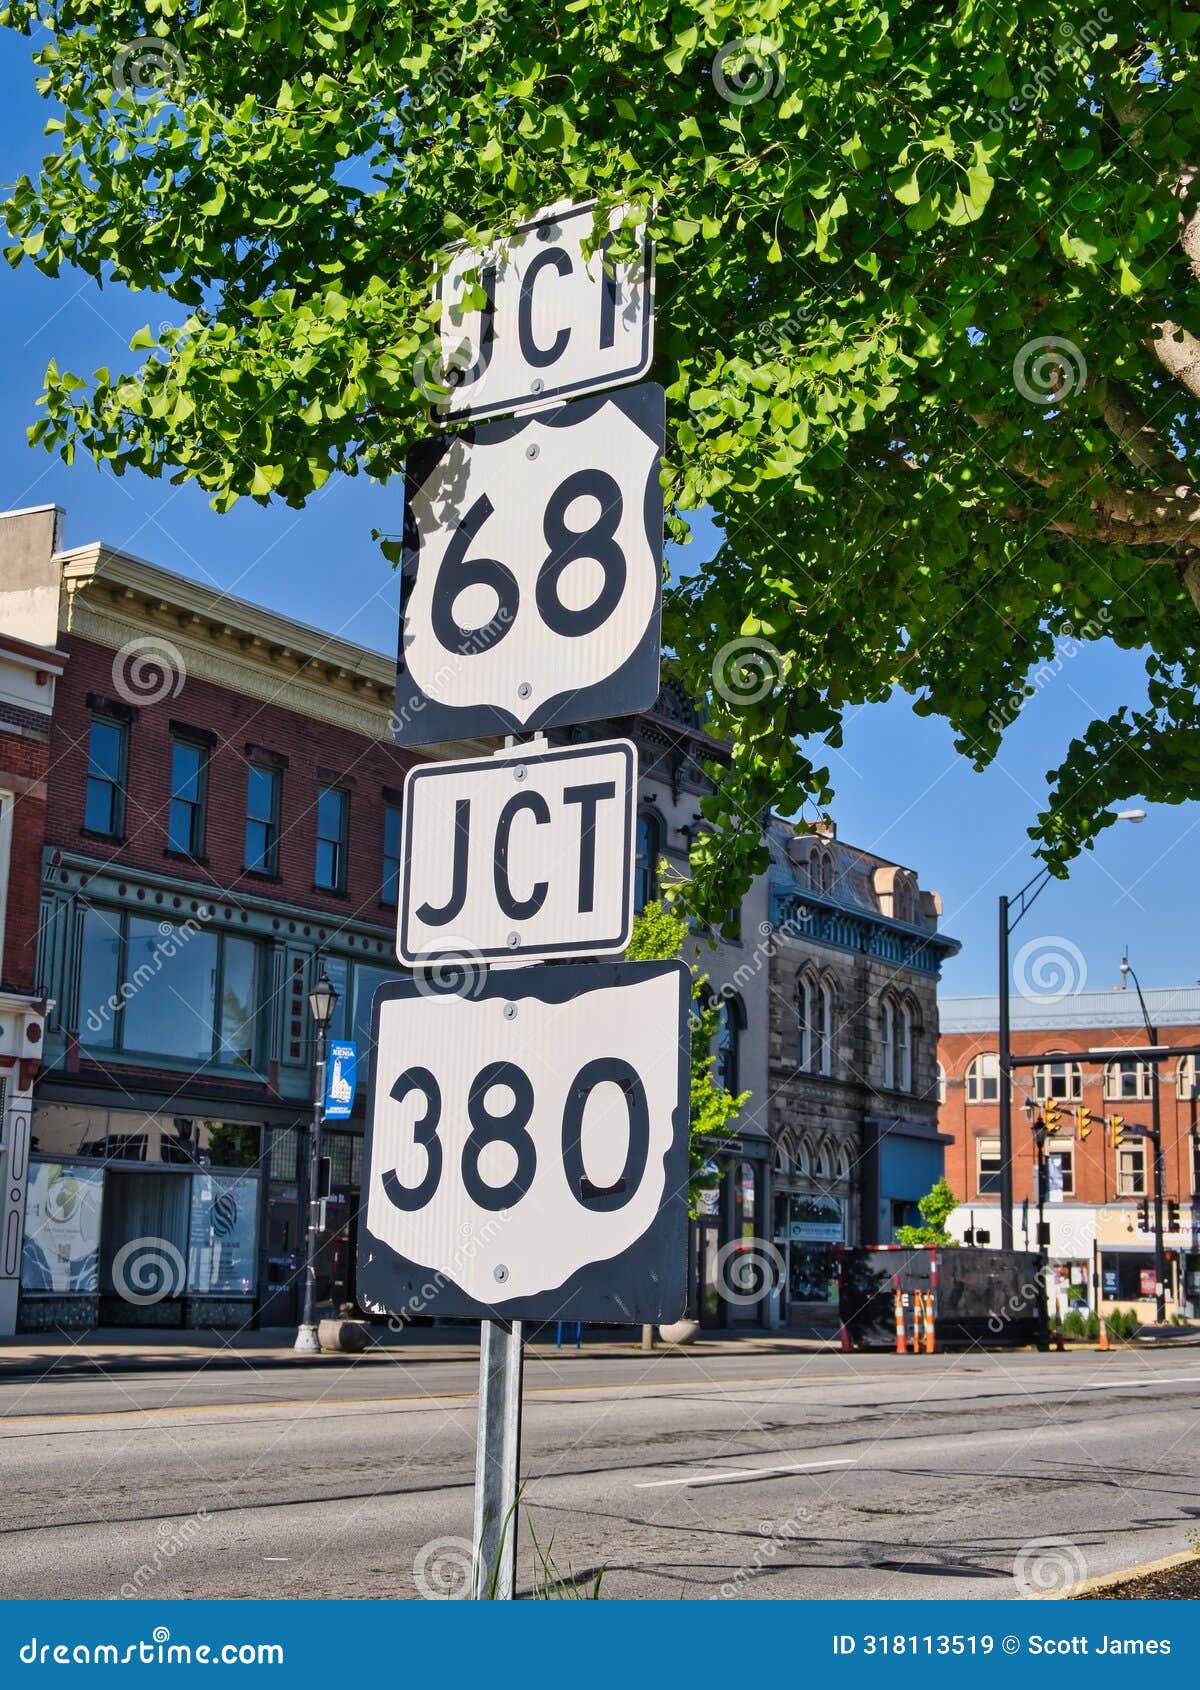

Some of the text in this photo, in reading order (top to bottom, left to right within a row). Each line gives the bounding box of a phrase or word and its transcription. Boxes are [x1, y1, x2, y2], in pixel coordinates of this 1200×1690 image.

[445, 222, 637, 388] JCT
[431, 468, 627, 656] 68
[415, 781, 616, 926] JCT
[381, 1057, 649, 1212] 380
